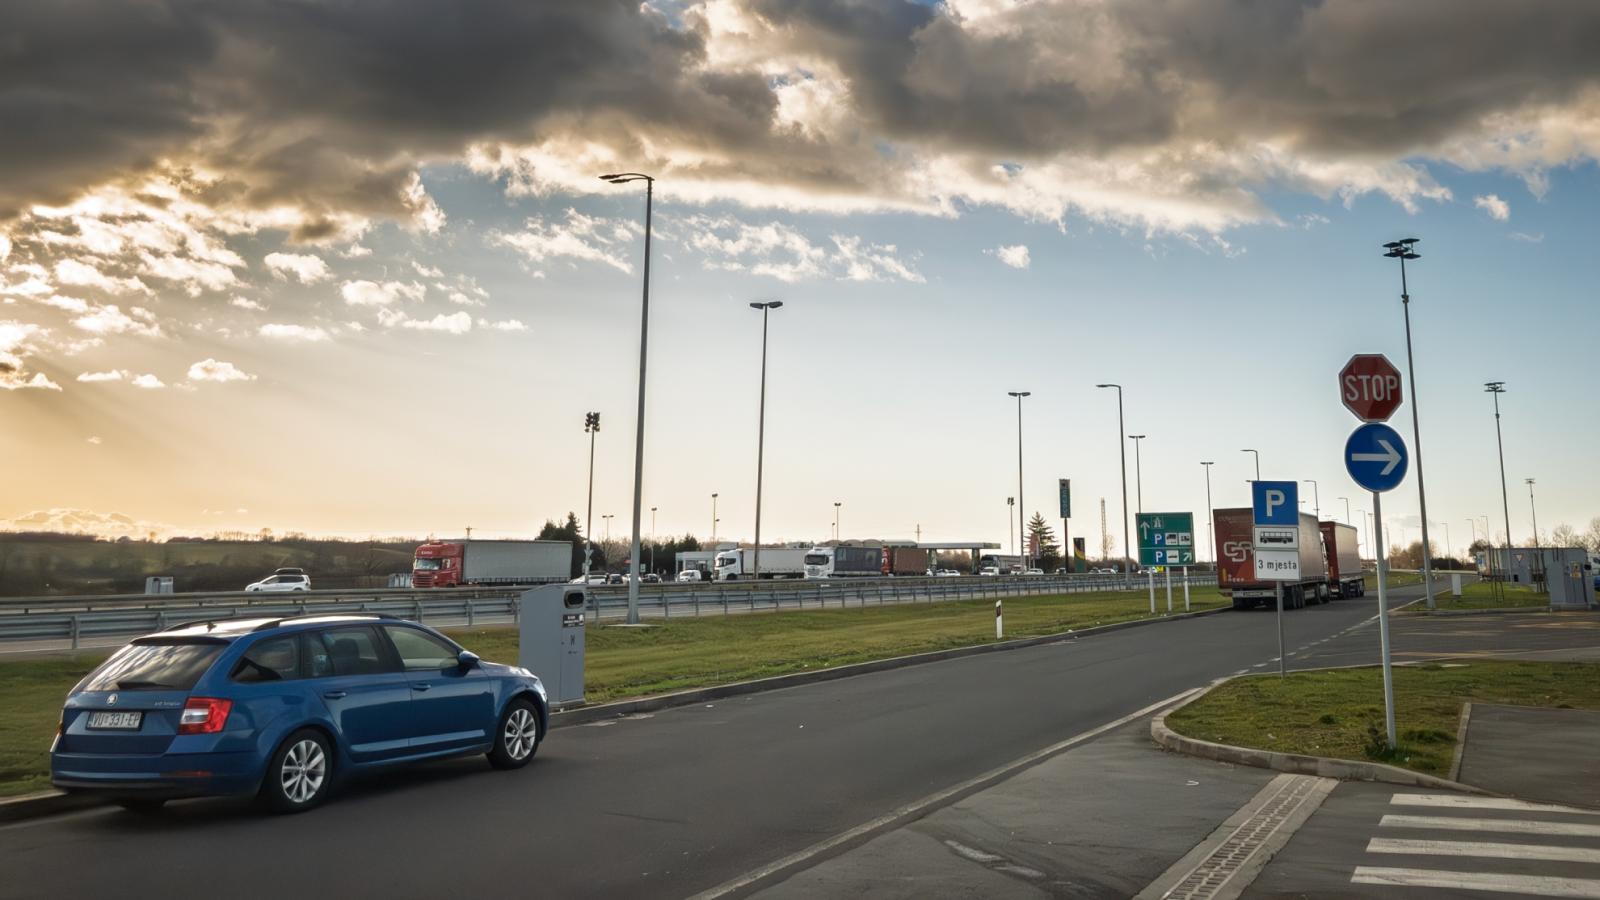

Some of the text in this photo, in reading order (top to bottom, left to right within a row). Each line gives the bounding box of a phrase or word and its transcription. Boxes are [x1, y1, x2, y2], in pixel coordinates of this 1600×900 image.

[1344, 374, 1398, 401] STOP
[1265, 489, 1286, 517] P
[1154, 533, 1162, 545] P
[1155, 551, 1163, 563] P
[1258, 559, 1297, 571] 3 mjesta
